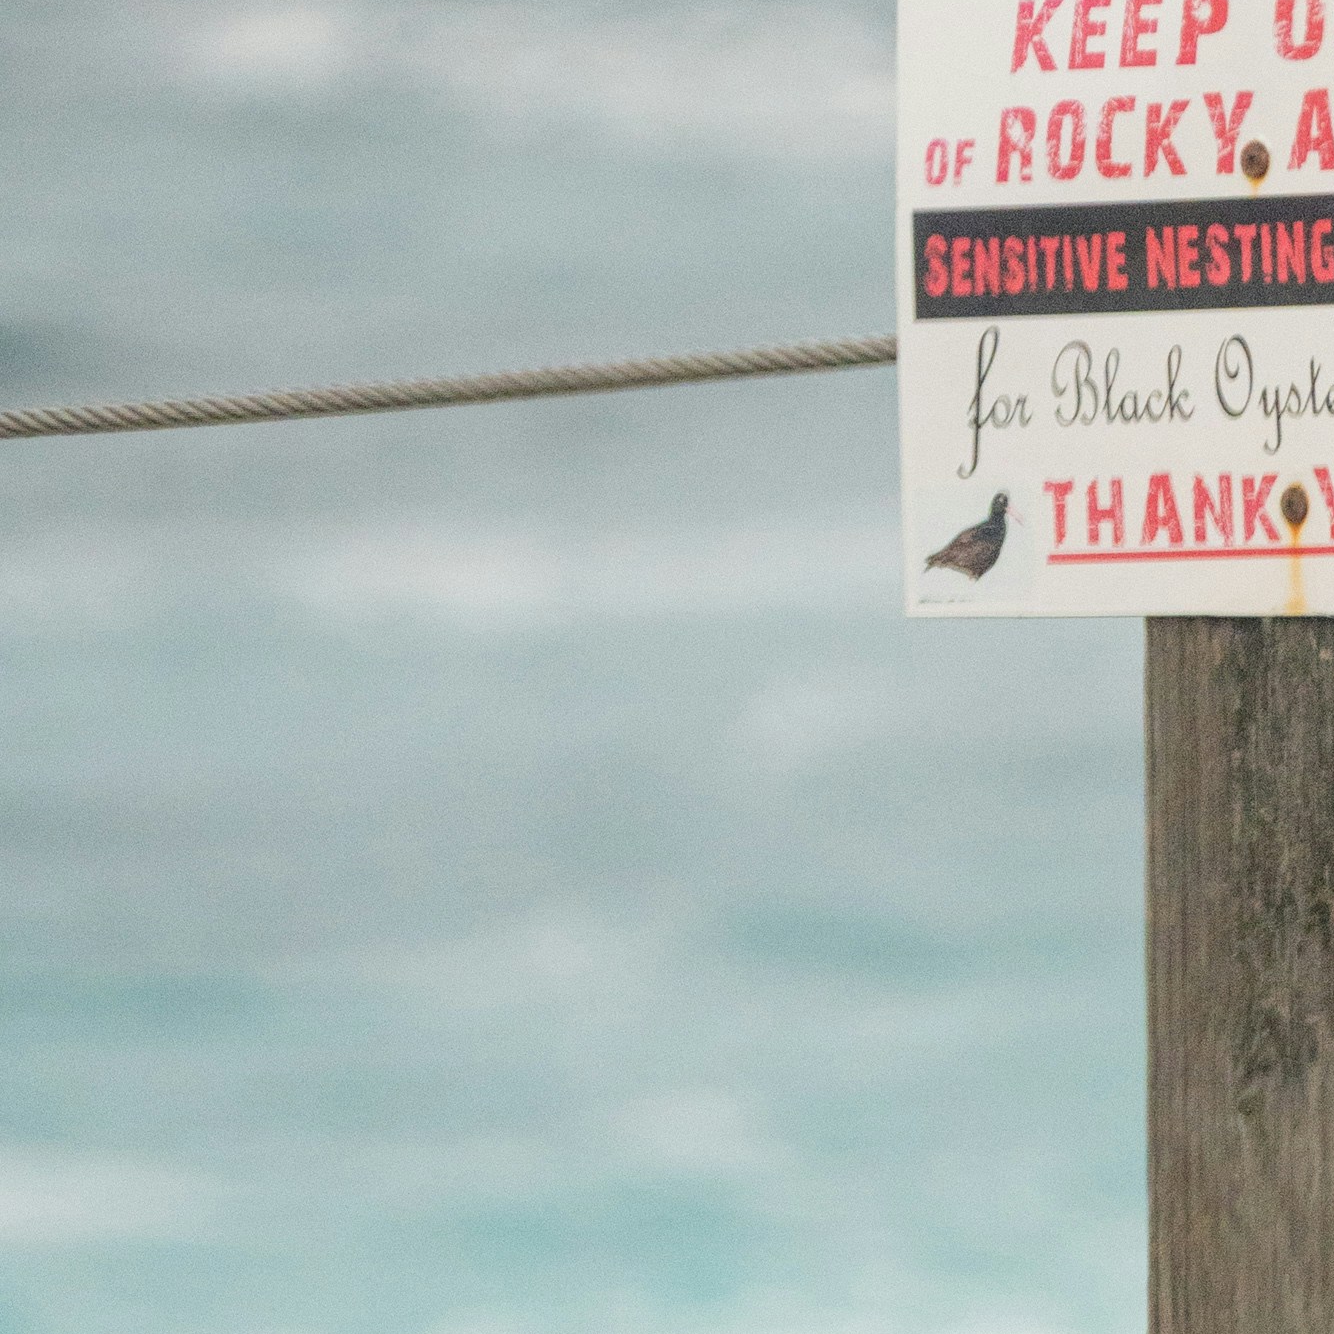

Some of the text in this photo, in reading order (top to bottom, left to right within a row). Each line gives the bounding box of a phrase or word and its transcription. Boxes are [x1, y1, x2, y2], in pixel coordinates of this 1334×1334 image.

[925, 138, 974, 186] OF
[996, 91, 1254, 184] ROCKY
[924, 230, 1129, 297] SENSITIVE
[957, 326, 1033, 479] for
[1050, 339, 1194, 427] Black
[1044, 471, 1280, 549] THANK
